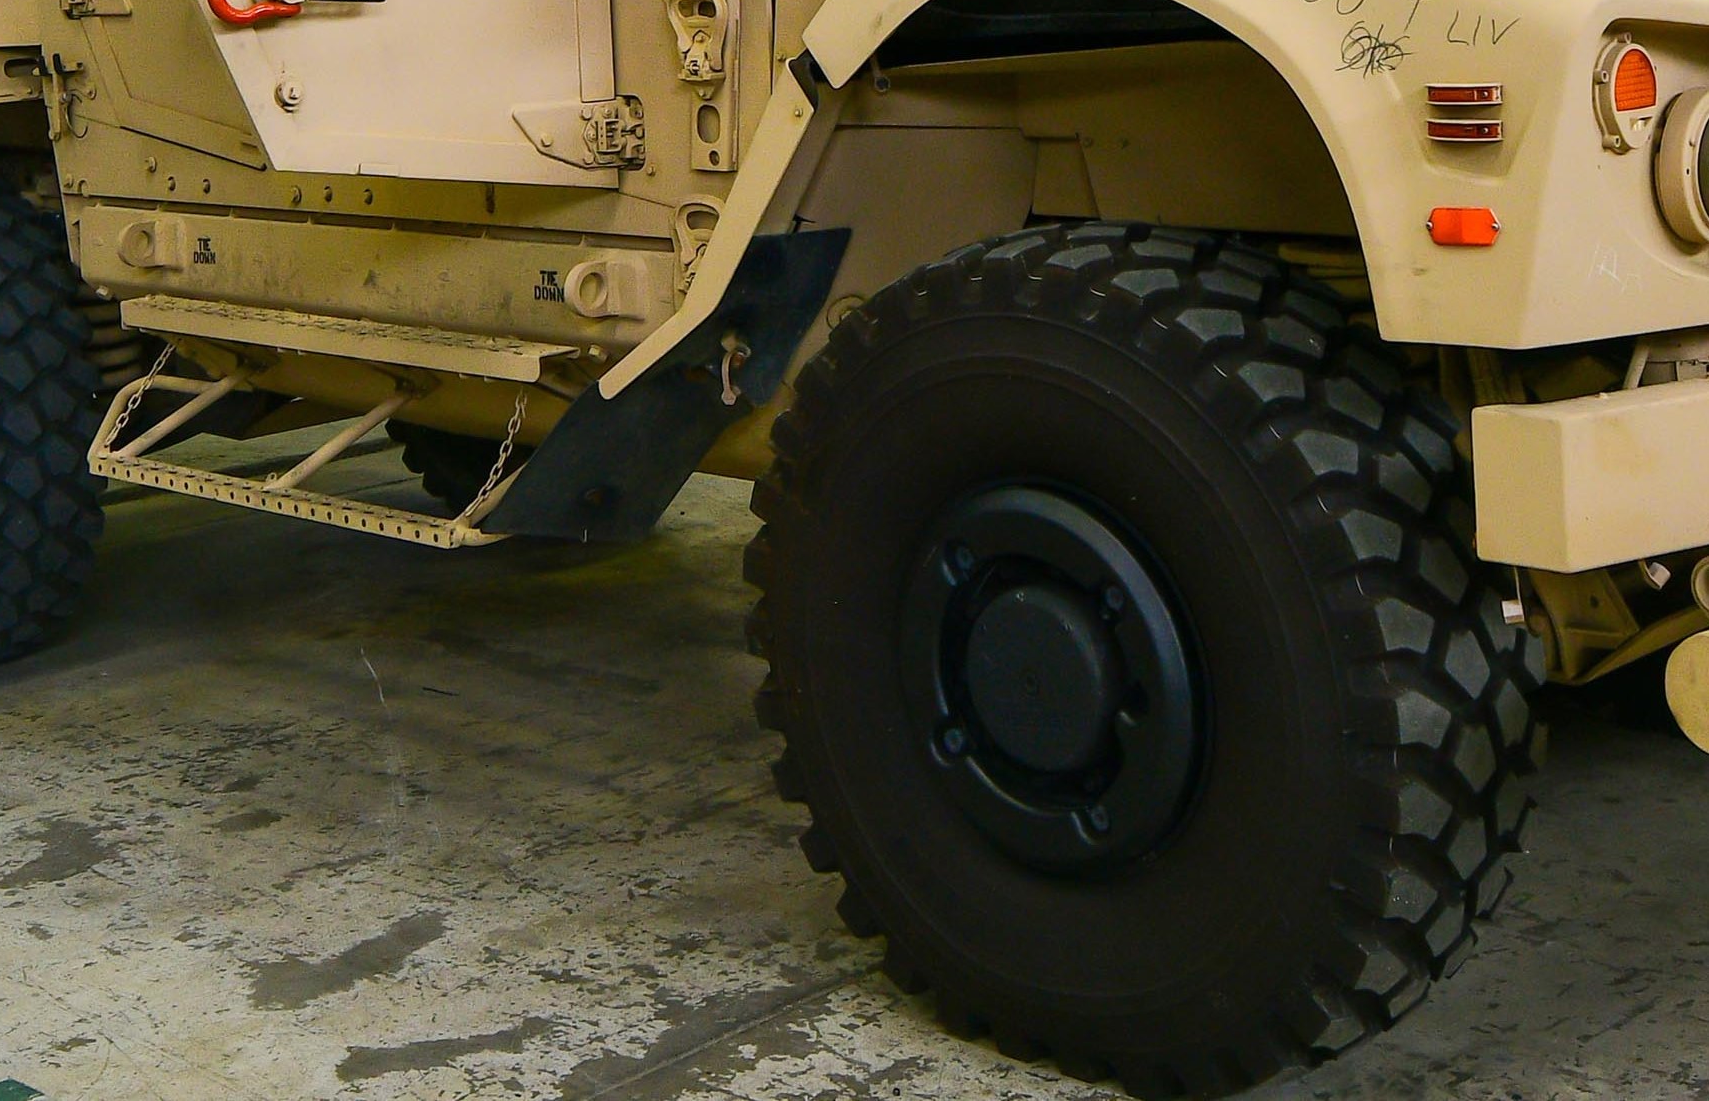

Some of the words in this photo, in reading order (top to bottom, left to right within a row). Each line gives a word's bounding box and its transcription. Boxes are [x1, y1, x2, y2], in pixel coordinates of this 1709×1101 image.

[1447, 10, 1521, 46] LIV
[197, 237, 211, 251] TIE
[193, 251, 216, 264] DOWN
[539, 270, 558, 286] TIE
[534, 285, 565, 303] DOWN
